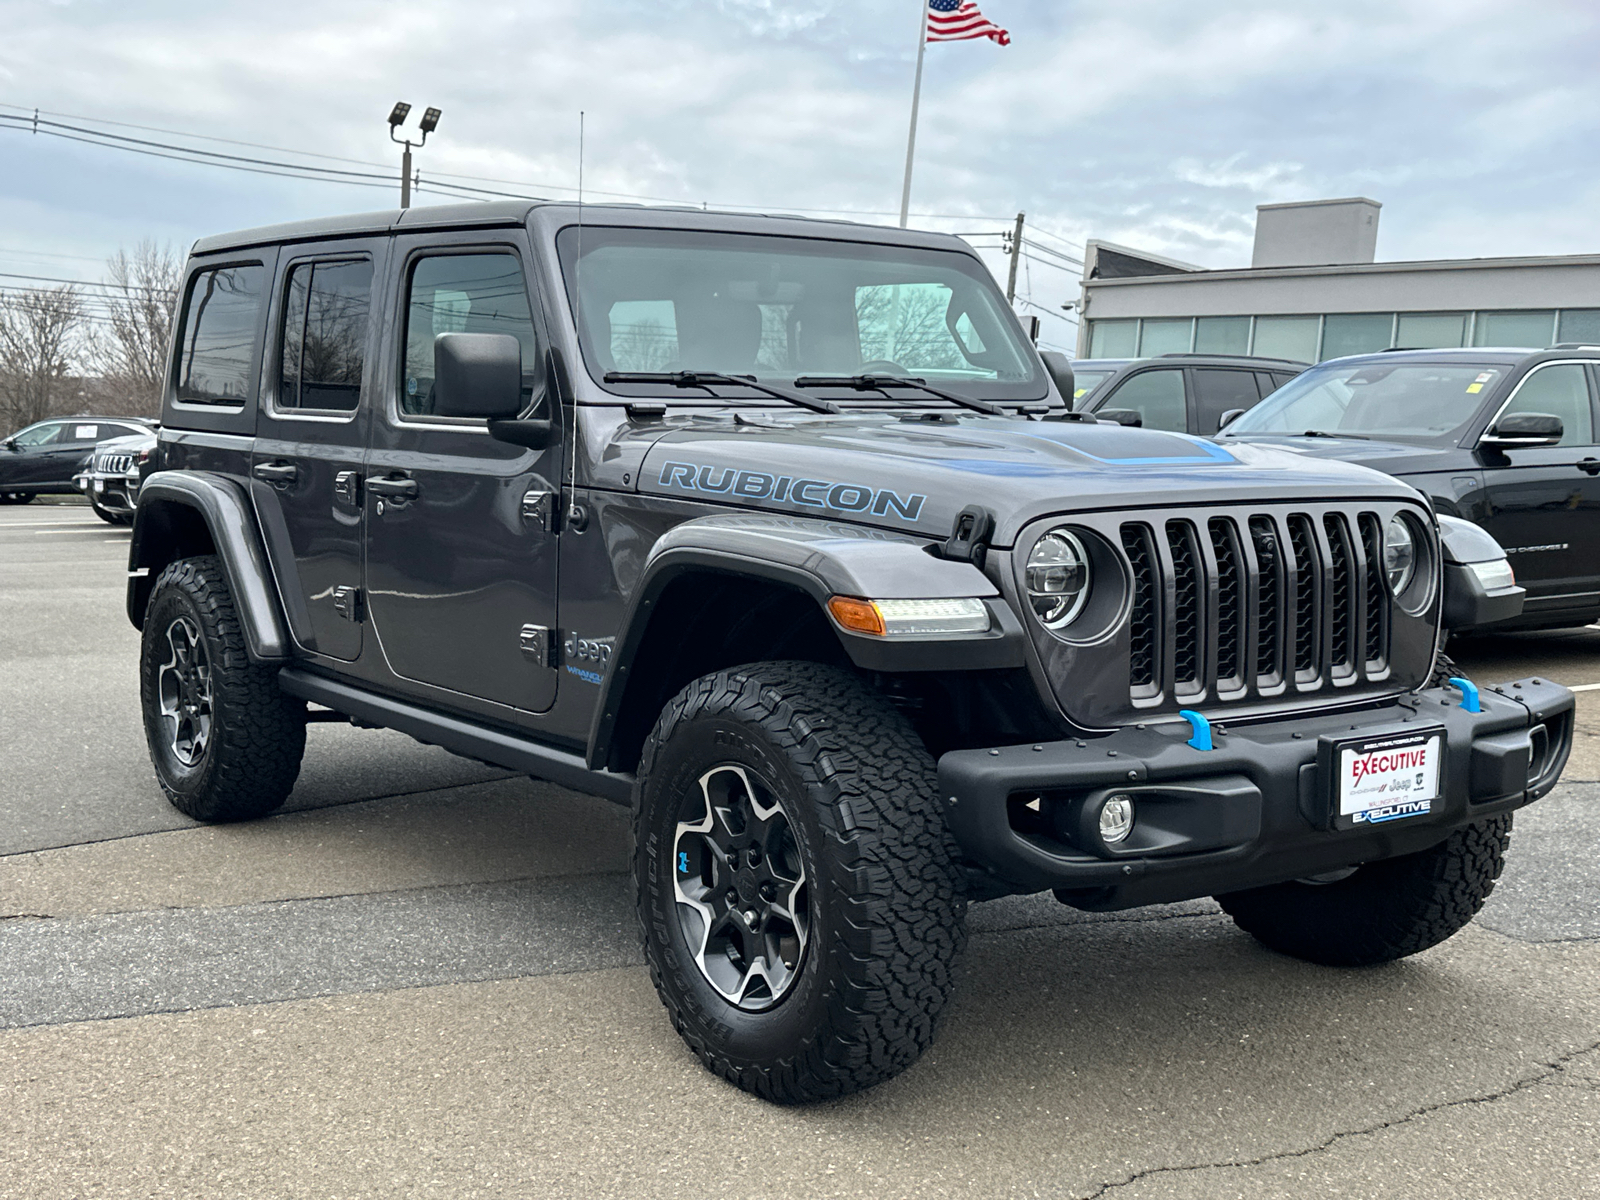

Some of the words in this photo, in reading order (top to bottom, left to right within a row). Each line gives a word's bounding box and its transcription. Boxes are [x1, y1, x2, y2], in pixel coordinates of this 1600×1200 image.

[658, 460, 928, 522] RUBICON
[564, 631, 612, 670] Jeep
[566, 664, 604, 681] WRANGL
[1352, 750, 1426, 787] EXECUTIVE
[1388, 779, 1411, 792] Jeep
[1353, 801, 1430, 823] EXECUTIVE
